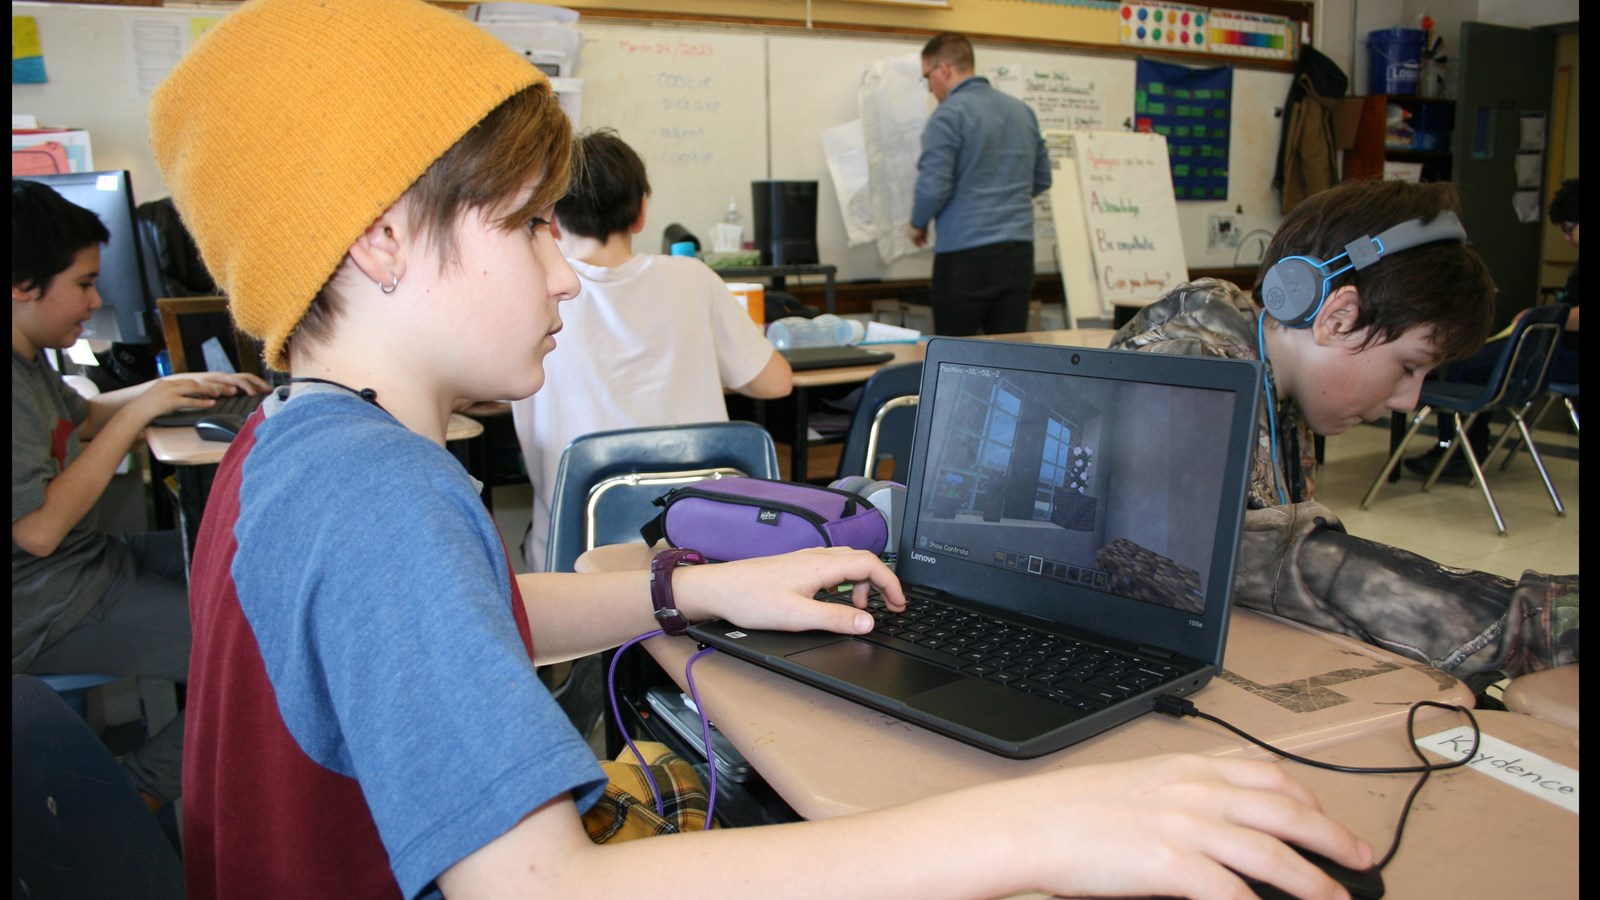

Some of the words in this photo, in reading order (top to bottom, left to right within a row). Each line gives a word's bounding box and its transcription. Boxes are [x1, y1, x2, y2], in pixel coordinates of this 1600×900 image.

[929, 540, 942, 550] Show
[944, 544, 969, 556] Controls
[911, 551, 936, 564] Lenovo
[1189, 619, 1203, 628] 100e
